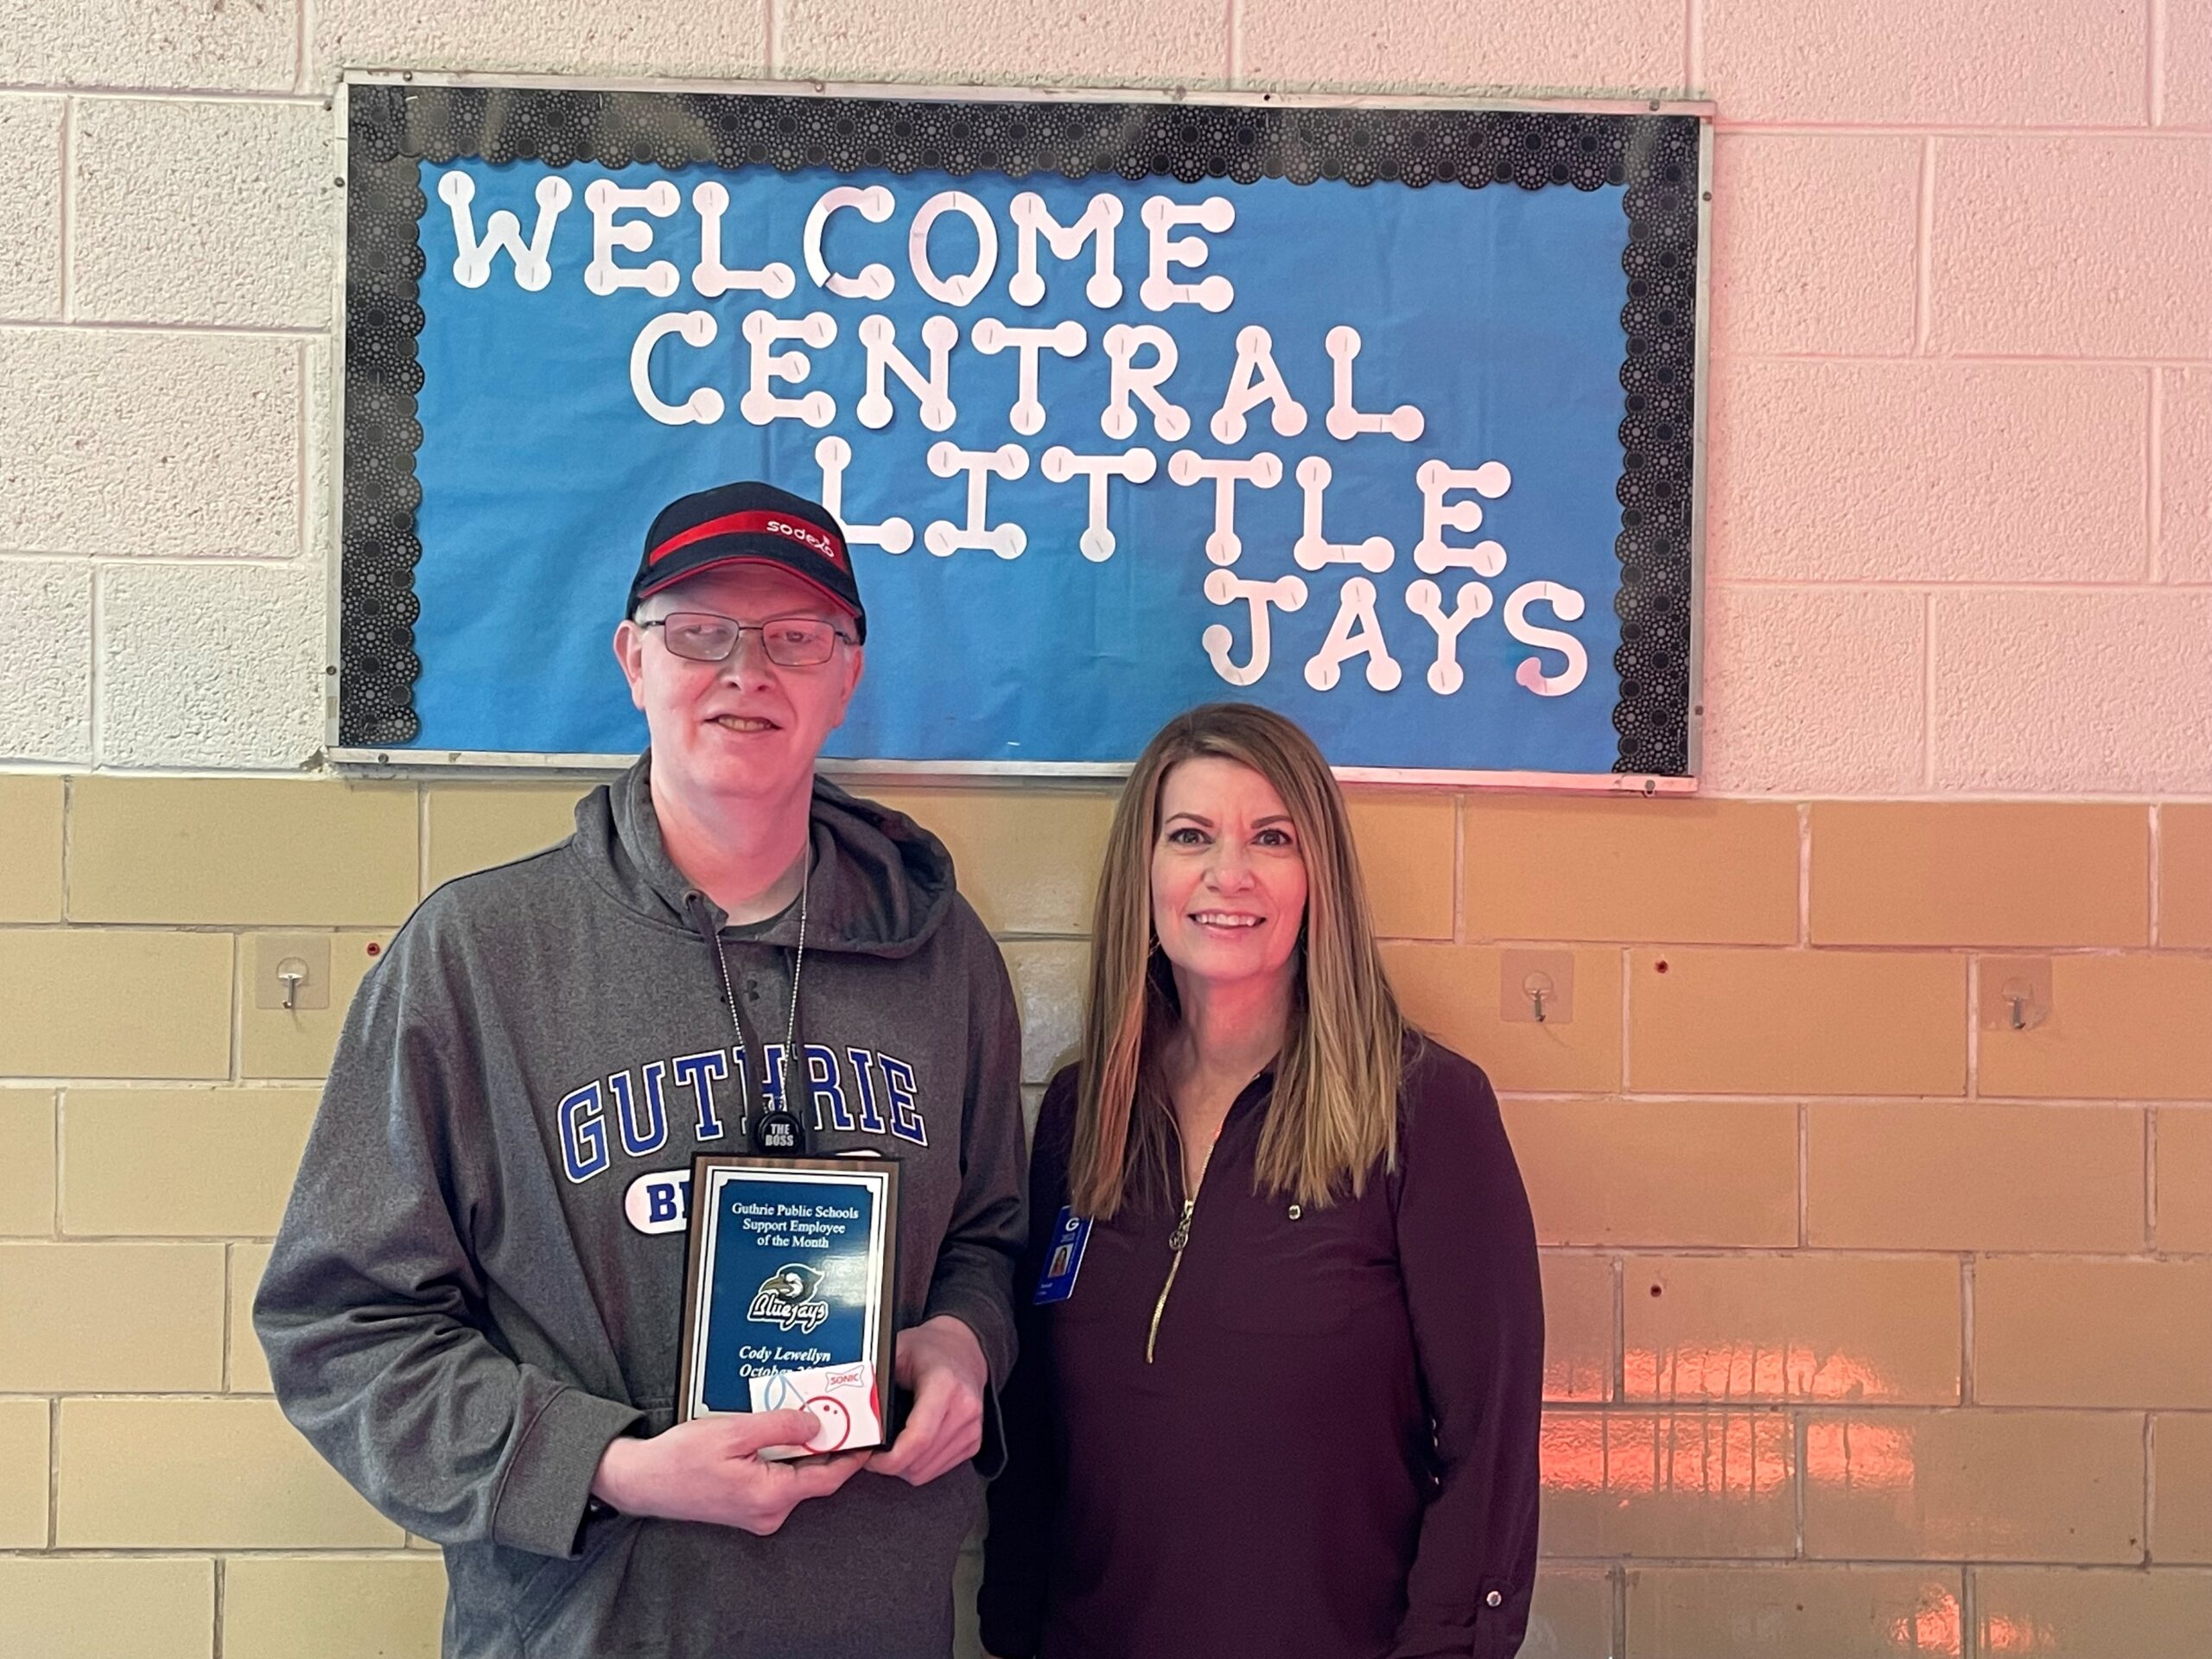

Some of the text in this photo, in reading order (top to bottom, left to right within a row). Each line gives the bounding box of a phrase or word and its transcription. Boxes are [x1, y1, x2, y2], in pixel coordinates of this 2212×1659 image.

[438, 170, 1236, 313] WELCOME
[630, 309, 1426, 444] CENTRAL
[814, 435, 1512, 577] LITTLE
[766, 521, 835, 558] sodexo
[1203, 568, 1588, 697] JAYS
[557, 1044, 929, 1184] GUTHRIE
[771, 1124, 790, 1135] THE
[765, 1135, 793, 1147] BOSS
[732, 1202, 859, 1218] Guthrie Public Schools
[743, 1218, 846, 1236] Support Employee
[757, 1235, 829, 1248] of the Month
[739, 1345, 831, 1364] Cody Lewellyn
[830, 1373, 859, 1385] SONIC
